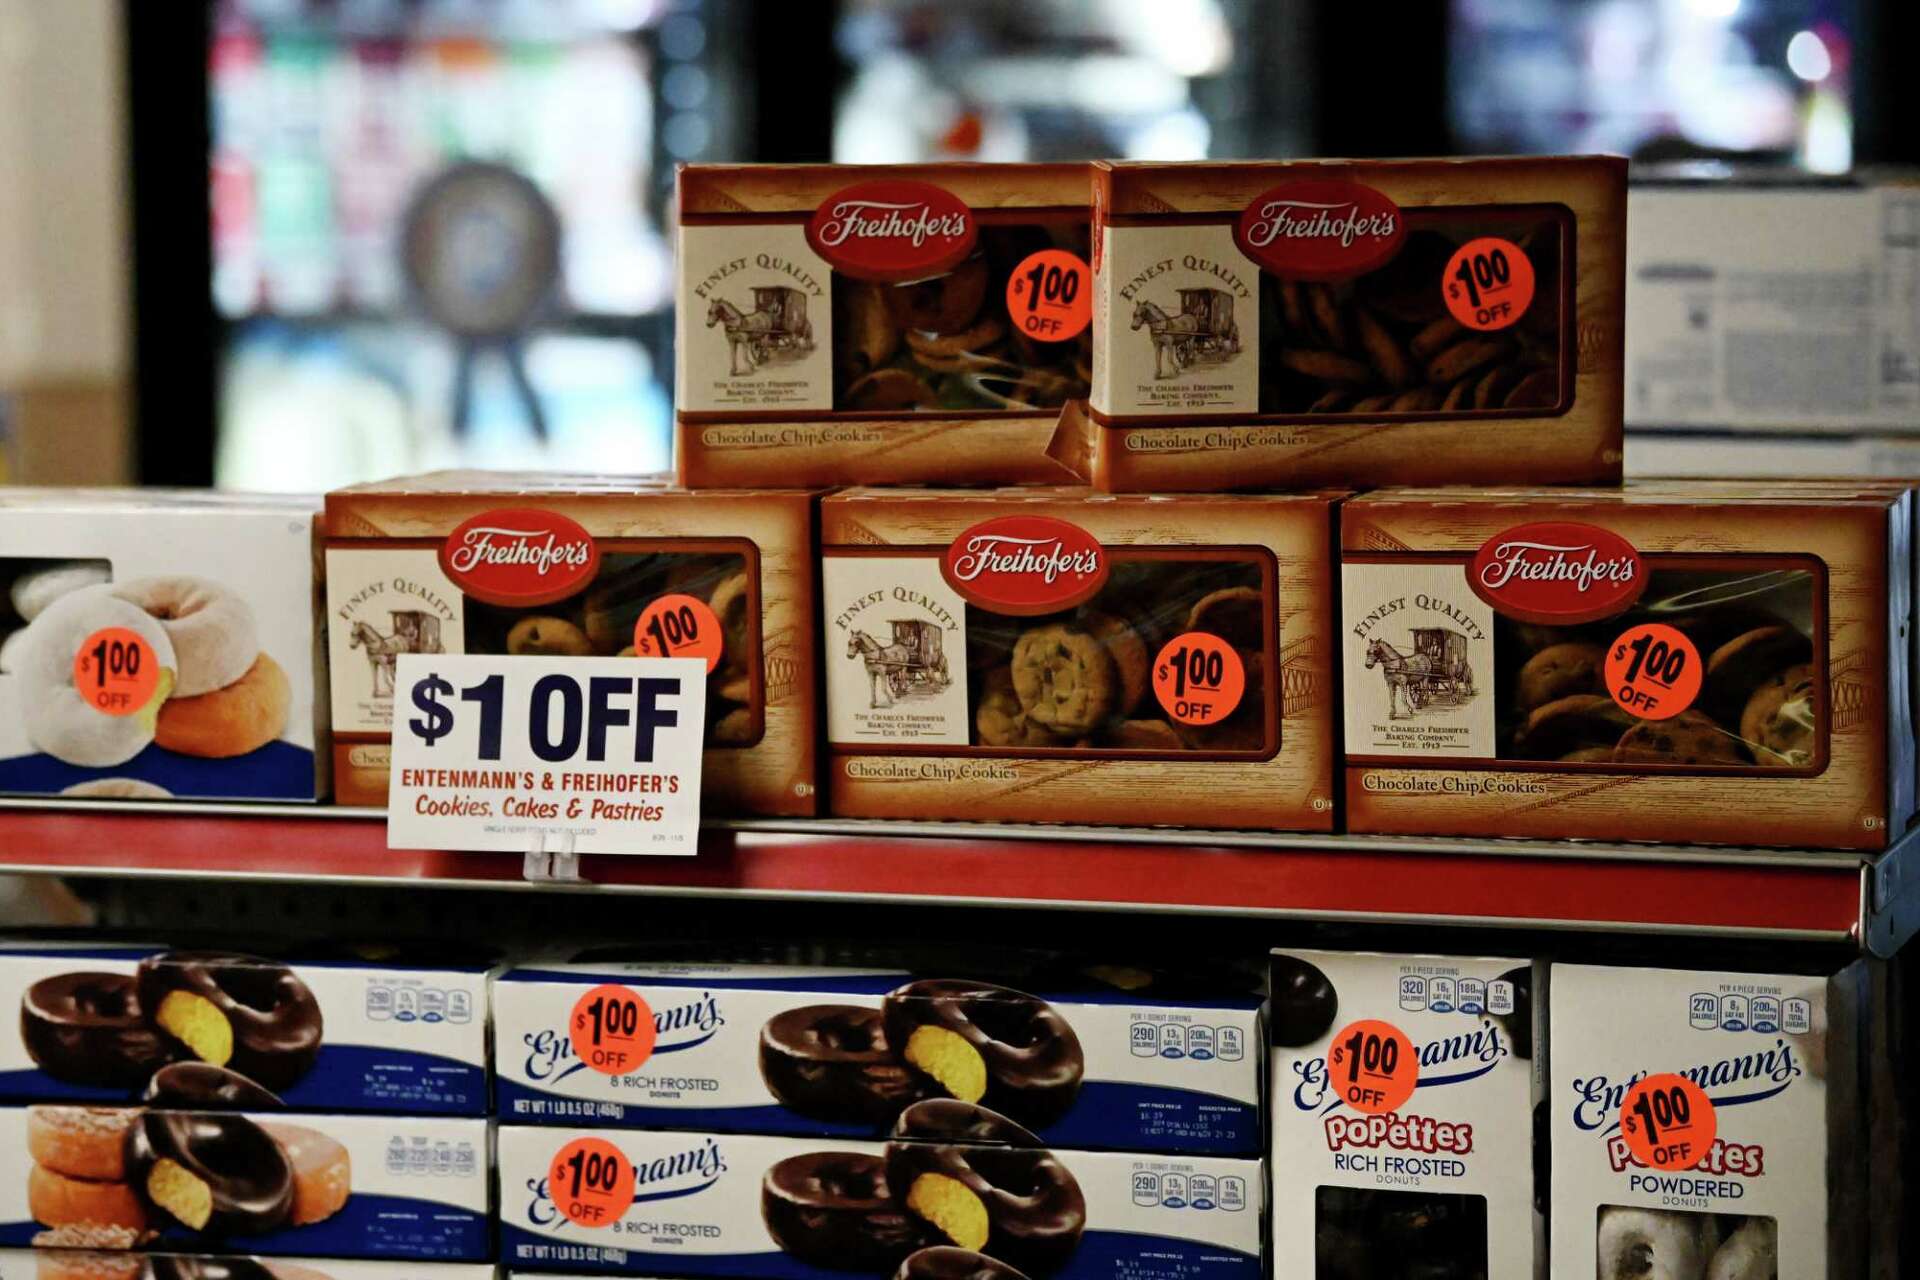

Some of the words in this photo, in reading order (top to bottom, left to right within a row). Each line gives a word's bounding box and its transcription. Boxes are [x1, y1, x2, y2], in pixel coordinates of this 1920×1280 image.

[819, 200, 965, 247] Freihofer's
[1247, 201, 1395, 248] Freihofer's
[694, 257, 748, 299] FINEST
[756, 254, 825, 298] QUALITY
[1119, 258, 1175, 302] FINEST
[1182, 254, 1252, 300] QUALITY
[1475, 302, 1512, 325] OFF
[1025, 316, 1062, 334] OFF
[1127, 435, 1200, 449] Chocolate
[1205, 433, 1242, 451] Chip
[451, 528, 588, 575] Freihofer's
[954, 535, 1098, 584] Freihofer's
[1481, 541, 1634, 592] Freihofer's
[338, 581, 385, 622] FINEST
[392, 577, 457, 623] QUALITY
[835, 590, 885, 631] FINEST
[892, 586, 959, 633] QUALITY
[1353, 597, 1406, 639] FINEST
[1414, 594, 1486, 642] QUALITY
[97, 692, 130, 708] OFF
[1619, 686, 1659, 712] OFF
[408, 674, 506, 761] $1
[529, 674, 681, 762] OFF
[1175, 703, 1212, 719] OFF
[401, 769, 534, 790] ENTENMANN'S
[542, 773, 554, 790] &
[562, 773, 679, 793] FREIHOFER'S
[848, 762, 917, 777] Chocolate
[920, 763, 956, 781] Chip
[959, 764, 1017, 779] Cookies
[1364, 774, 1438, 791] Chocolate
[1442, 776, 1479, 796] Chip
[1483, 777, 1545, 793] Cookies
[503, 796, 559, 818] Cakes
[566, 798, 583, 818] &
[591, 799, 664, 821] Pastries
[1403, 981, 1423, 993] 320
[1693, 999, 1714, 1012] 270
[1133, 1028, 1154, 1040] 290
[592, 1049, 626, 1068] OFF
[611, 1076, 619, 1087] 8
[624, 1077, 656, 1088] RICH
[661, 1078, 719, 1091] FROSTED
[1348, 1086, 1385, 1106] OFF
[514, 1100, 530, 1113] NET
[533, 1101, 546, 1113] WT
[555, 1102, 566, 1115] LB
[1334, 1153, 1378, 1172] RICH
[1384, 1156, 1465, 1177] FROSTED
[1654, 1143, 1692, 1165] OFF
[1136, 1177, 1156, 1189] 290
[1376, 1175, 1421, 1186] DONUTS
[1631, 1175, 1744, 1199] POWDERED
[569, 1203, 604, 1221] OFF
[1662, 1196, 1709, 1208] DONUTS
[627, 1222, 658, 1235] RICH
[663, 1224, 721, 1238] FROSTED
